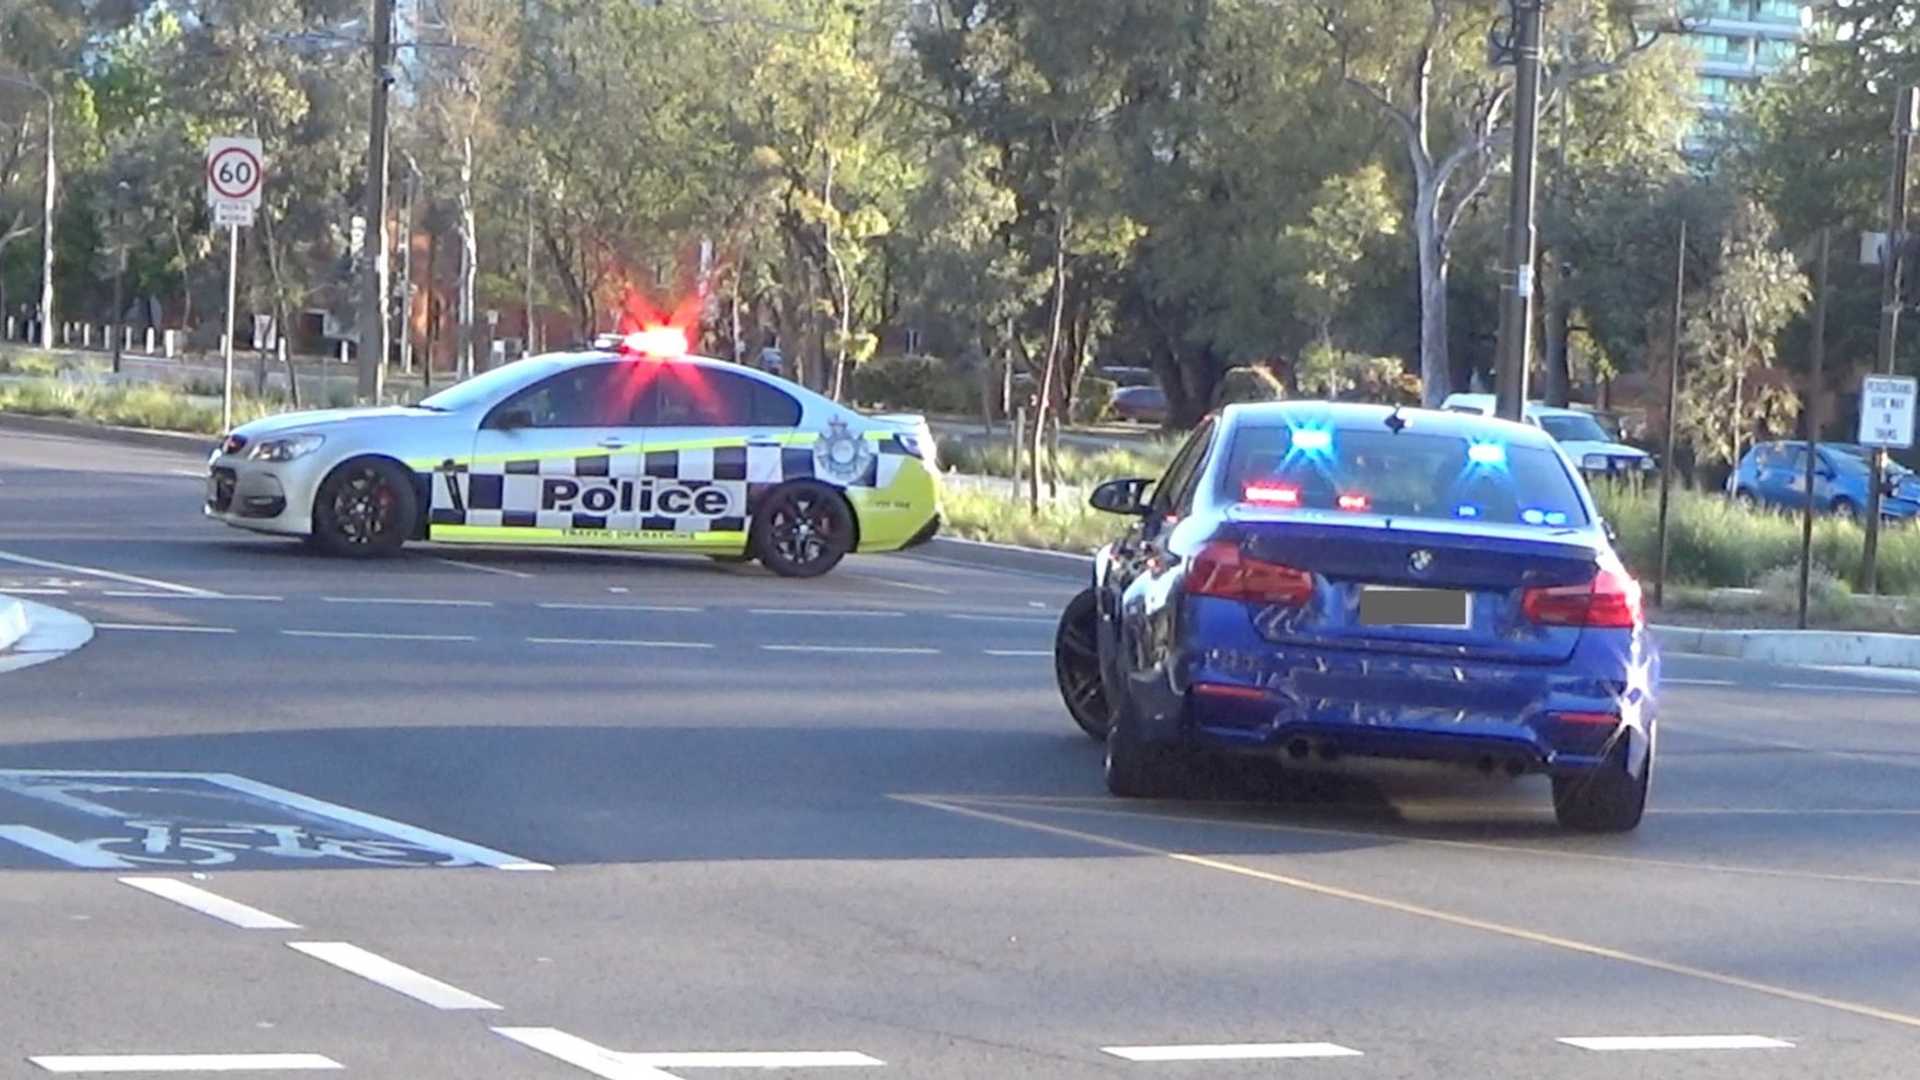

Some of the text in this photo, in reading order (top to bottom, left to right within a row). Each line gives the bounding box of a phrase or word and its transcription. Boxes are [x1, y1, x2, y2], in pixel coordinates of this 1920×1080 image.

[219, 162, 251, 184] 60
[541, 478, 729, 515] Police
[561, 529, 696, 541] TRAFFIC OPERATIONS
